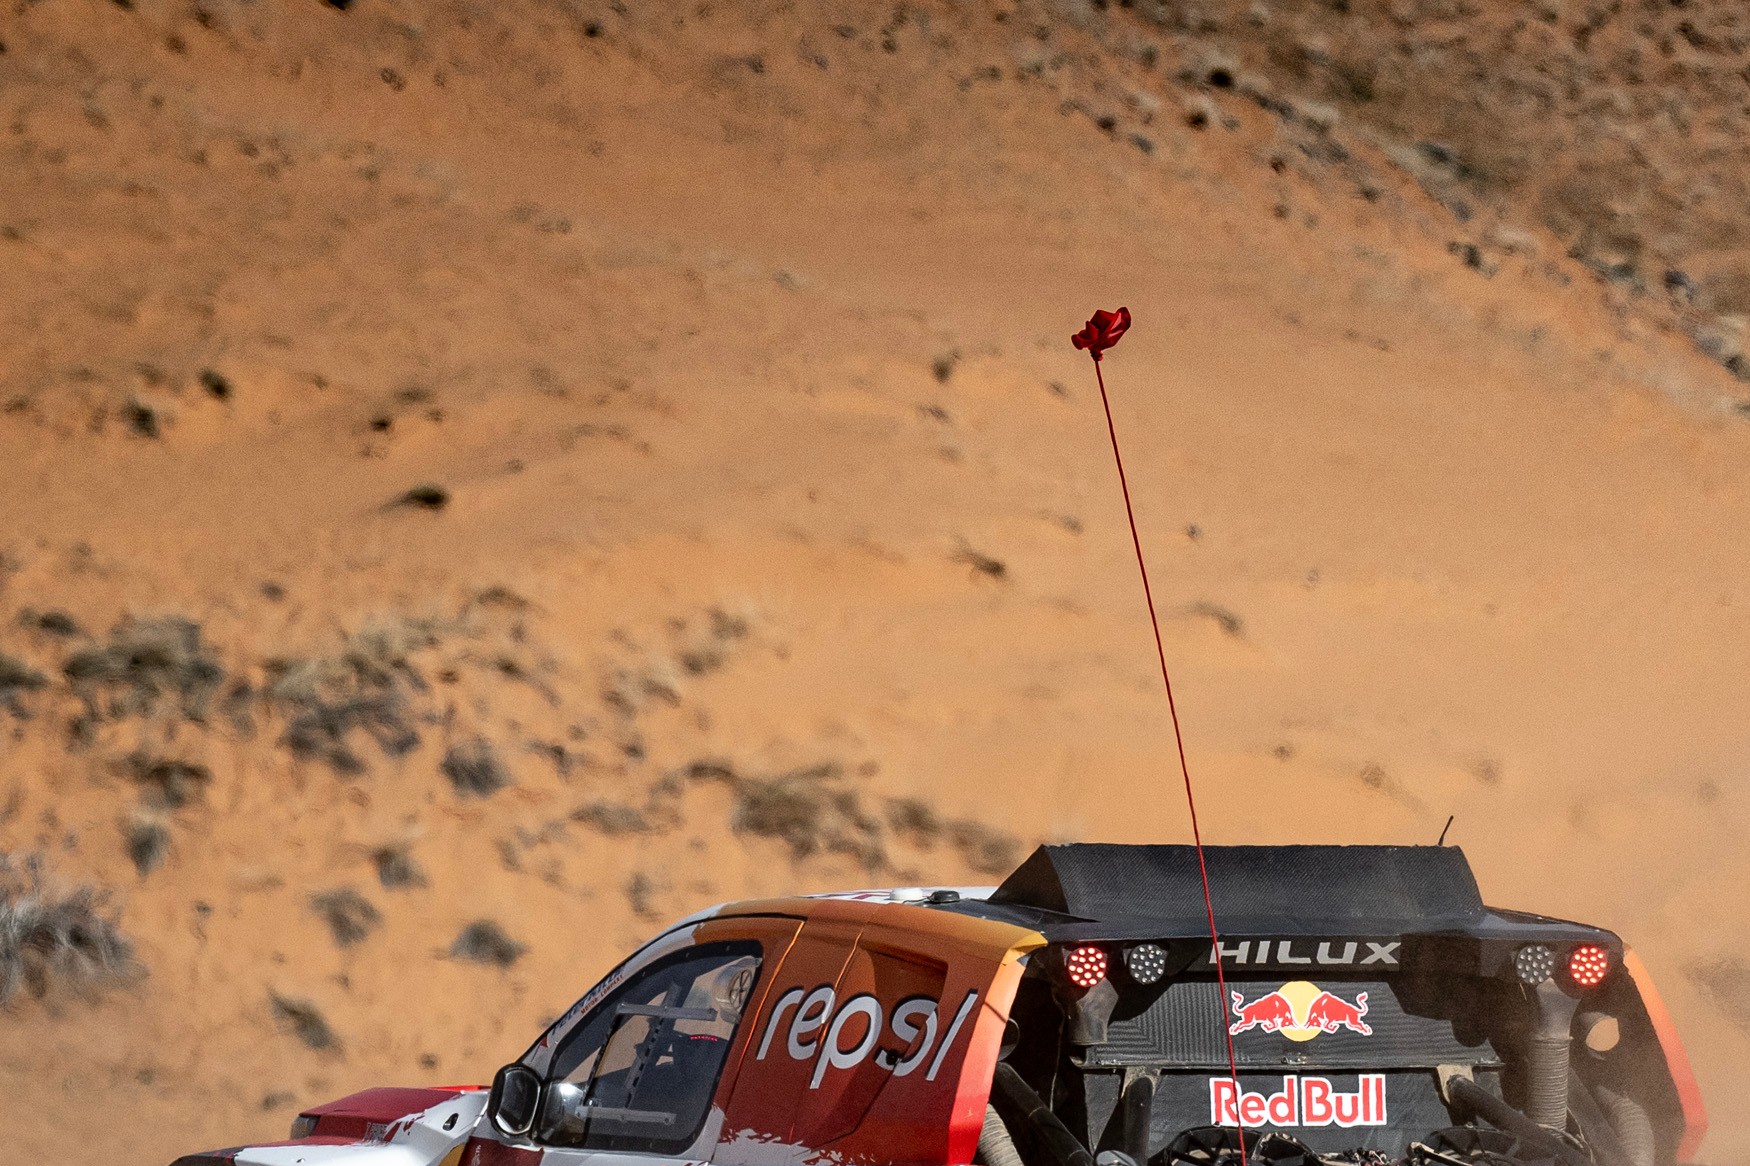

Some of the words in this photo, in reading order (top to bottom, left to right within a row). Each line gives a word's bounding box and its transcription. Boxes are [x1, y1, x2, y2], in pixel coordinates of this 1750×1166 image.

[1209, 940, 1402, 965] HILUX
[1211, 1076, 1297, 1125] Red
[1303, 1075, 1386, 1125] Bull
